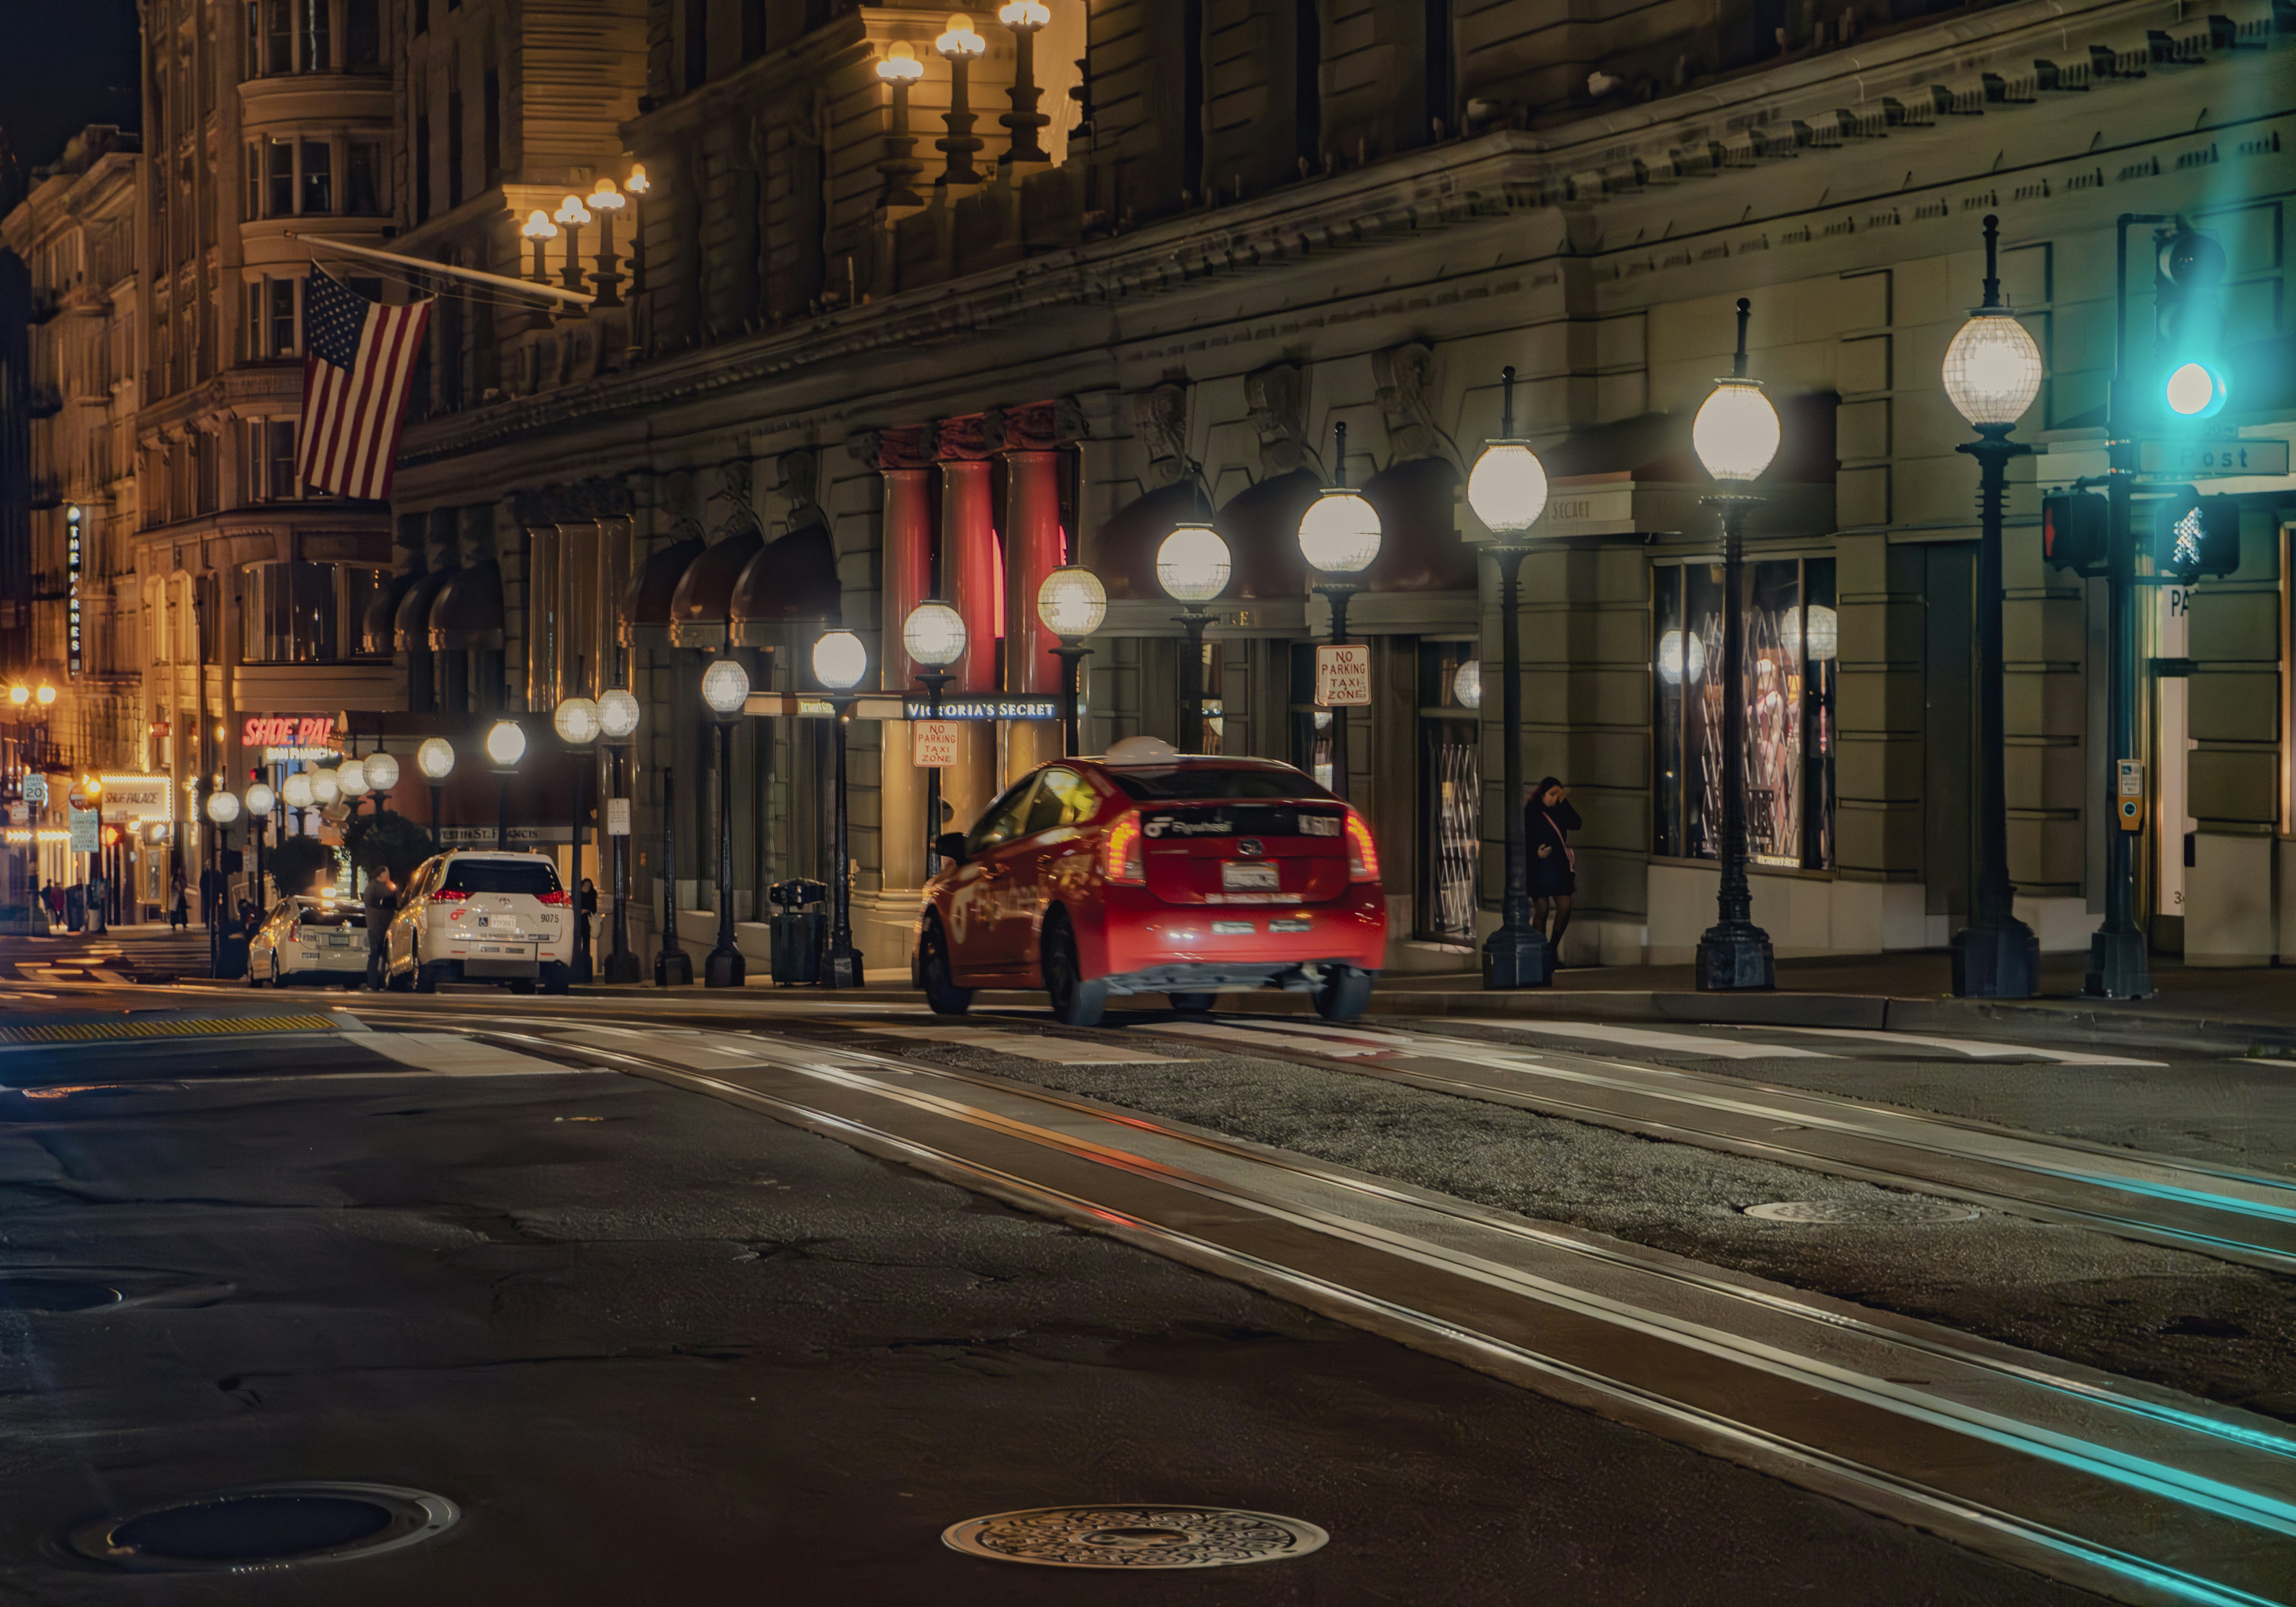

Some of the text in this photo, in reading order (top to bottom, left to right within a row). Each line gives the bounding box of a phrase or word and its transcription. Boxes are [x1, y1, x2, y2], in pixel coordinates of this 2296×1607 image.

[2181, 447, 2247, 468] Post
[1336, 651, 1353, 663] NO
[1322, 663, 1365, 675] PARKING
[1331, 678, 1359, 687] TAXI
[1327, 690, 1363, 699] ZONE
[999, 703, 1055, 716] SECRET
[242, 718, 299, 746] SHOE
[930, 725, 945, 734] NO
[918, 734, 955, 743] PARKING
[267, 748, 288, 759] SAN
[26, 788, 42, 797] 20
[541, 913, 559, 923] 9075
